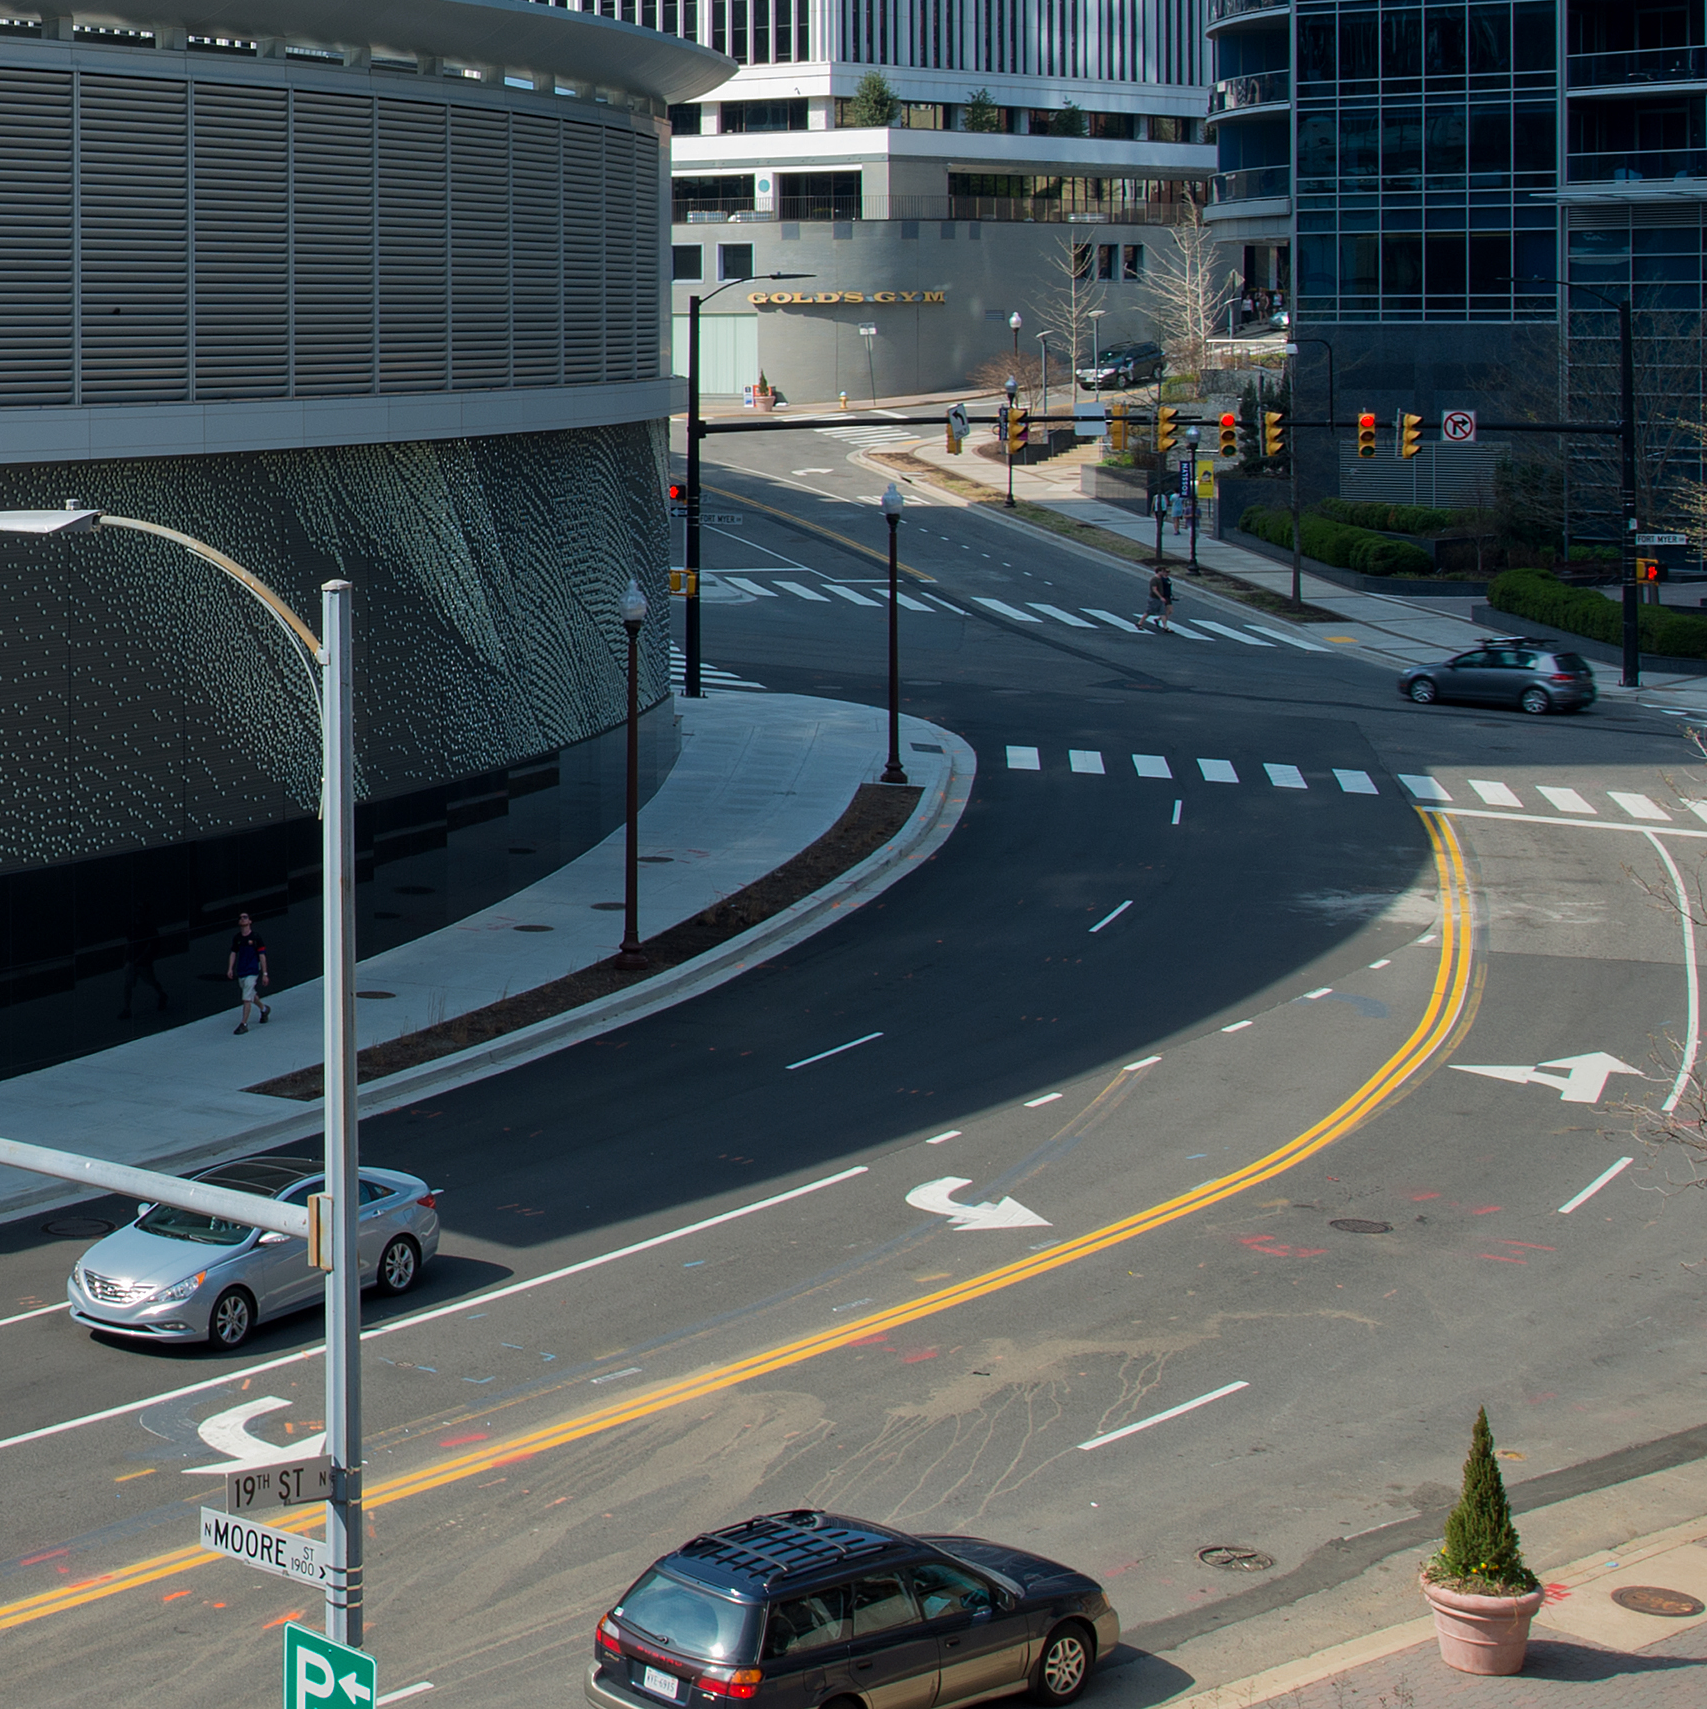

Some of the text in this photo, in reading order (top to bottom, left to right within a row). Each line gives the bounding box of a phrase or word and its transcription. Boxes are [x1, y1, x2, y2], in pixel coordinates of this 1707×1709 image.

[747, 291, 948, 304] GOLD'S GYM
[1181, 463, 1189, 495] ROSSLYN
[717, 514, 735, 523] MYER
[1637, 535, 1655, 543] FORT
[1656, 535, 1678, 543] MYER
[234, 1468, 327, 1508] 19TH ST N
[204, 1518, 315, 1567] N MOORE ST
[290, 1557, 315, 1577] 1900
[636, 1645, 683, 1667] SUBARU
[296, 1644, 335, 1709] P
